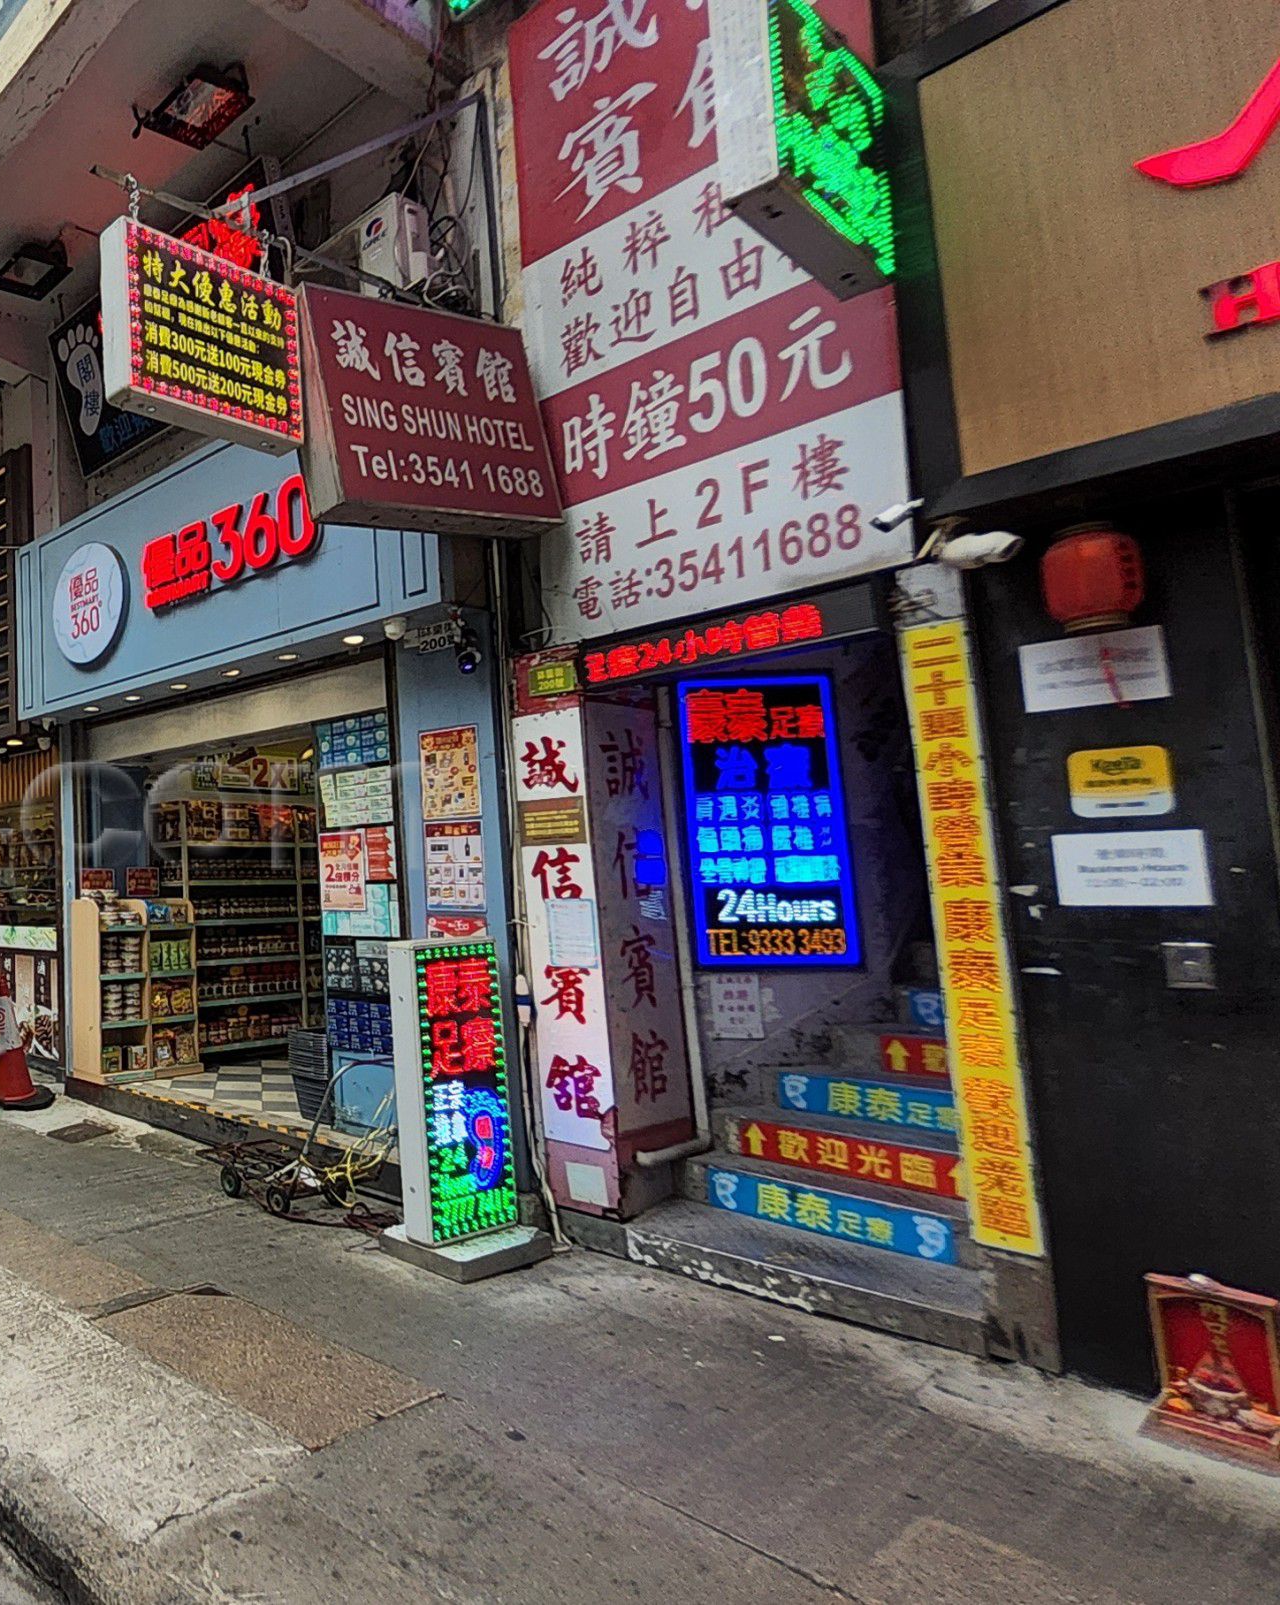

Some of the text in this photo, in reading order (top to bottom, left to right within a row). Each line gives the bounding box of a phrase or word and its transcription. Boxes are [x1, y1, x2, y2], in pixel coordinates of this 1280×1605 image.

[537, 0, 705, 101] 誠
[142, 250, 282, 331] 特大優惠活動
[560, 237, 803, 378] 歡迎自由
[145, 319, 286, 390] 消費300元送100元現金券
[146, 350, 288, 416] 消費500元送200元現金券
[331, 318, 518, 405] 誠信賓館
[342, 393, 534, 452] SING SHUN HOTEL
[563, 305, 853, 481] 時鐘50元
[350, 444, 545, 498] Tel:3541 1688
[576, 433, 850, 565] 請上2F樓
[142, 474, 316, 589] 優品 360
[573, 503, 863, 621] 電話:35411688
[70, 567, 98, 600] 優品
[717, 888, 837, 923] 24Hours
[777, 1130, 938, 1189] 歡迎光臨
[756, 1183, 895, 1247] 康泰足療
